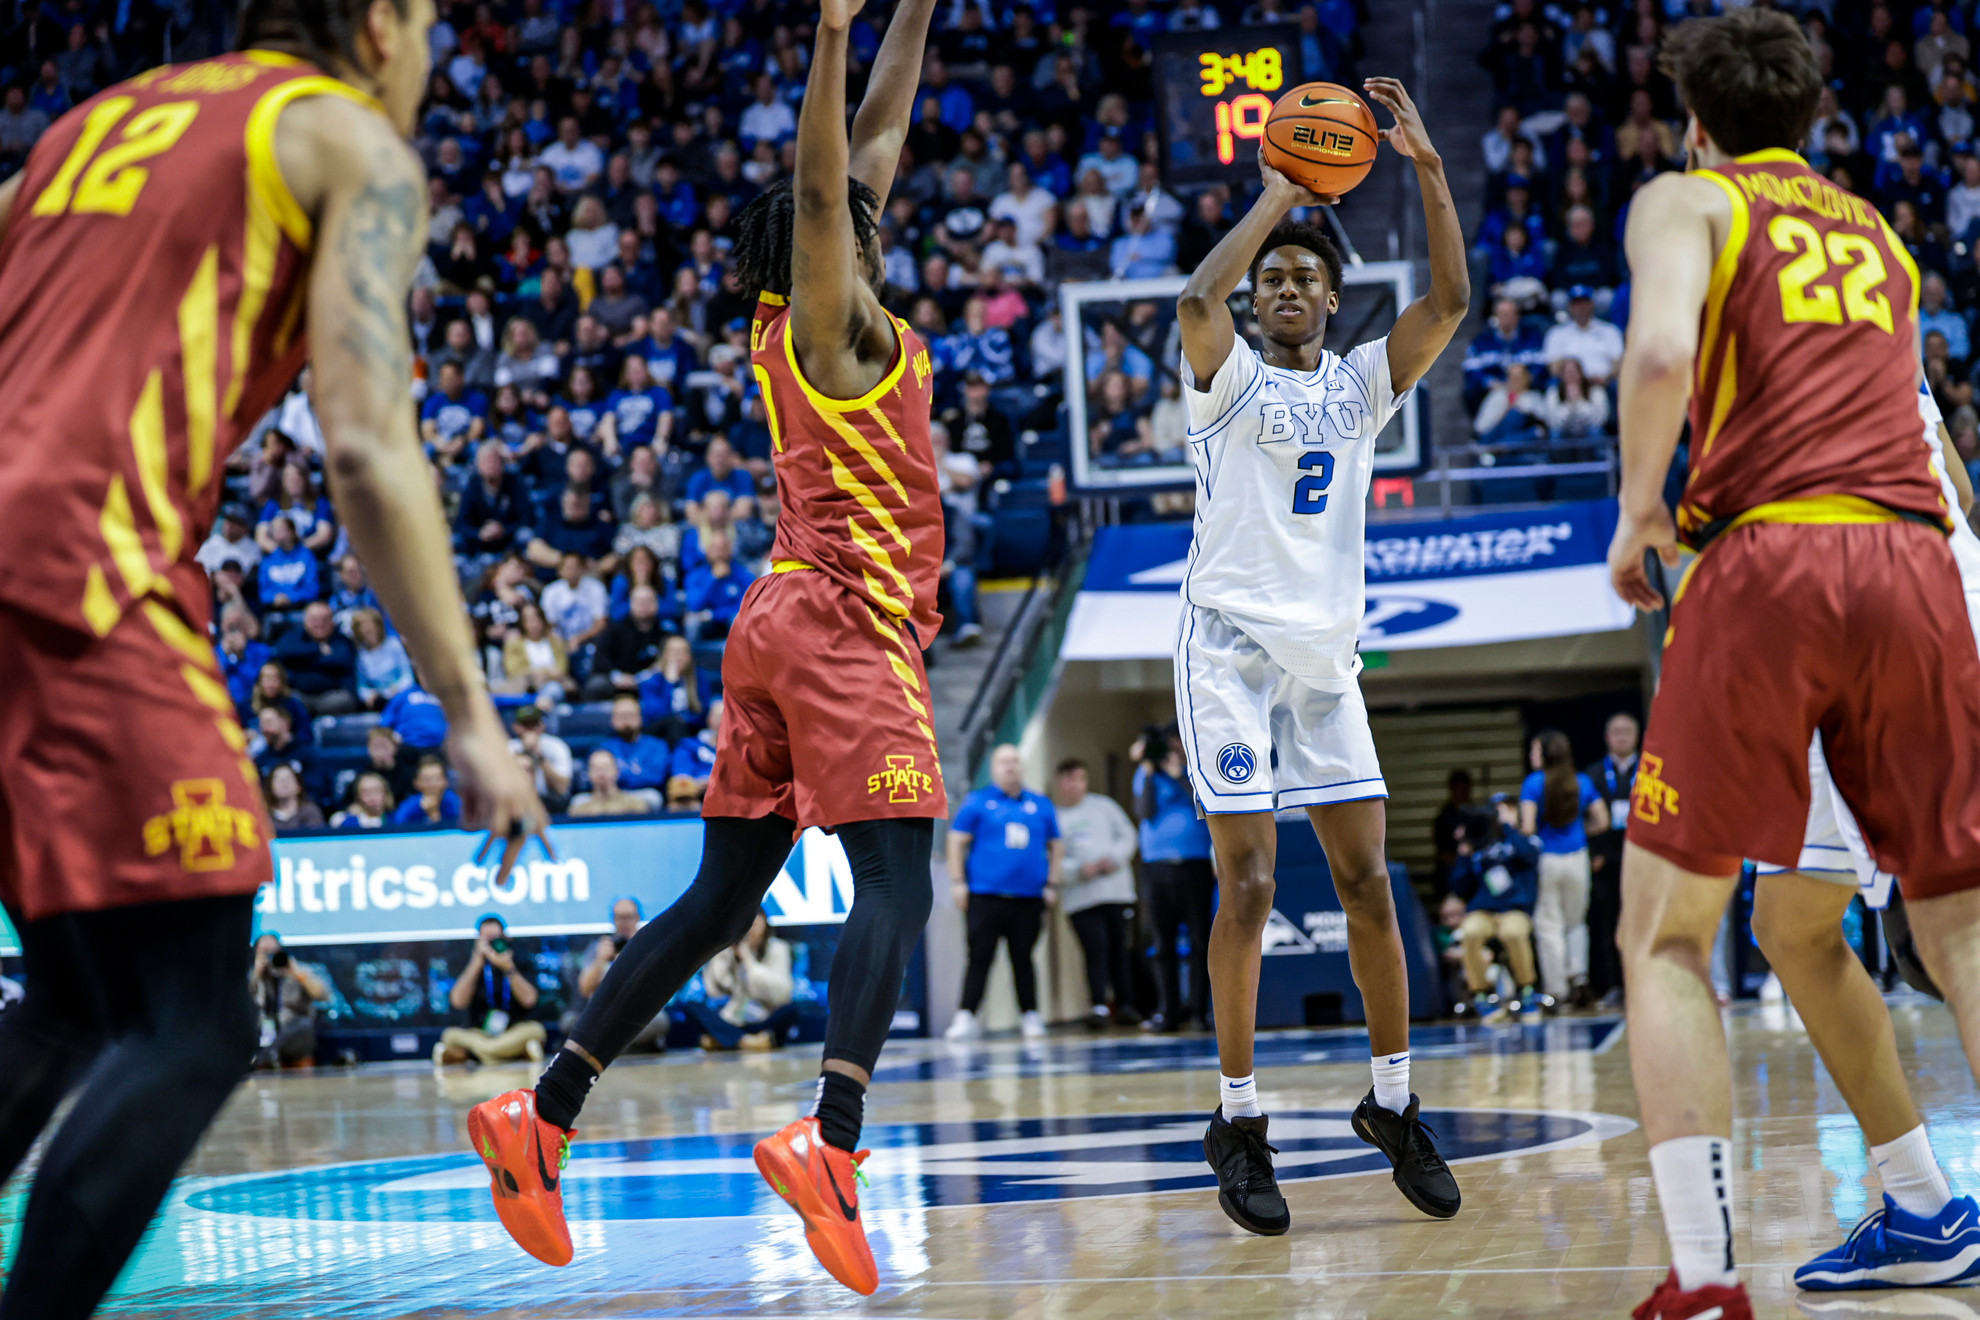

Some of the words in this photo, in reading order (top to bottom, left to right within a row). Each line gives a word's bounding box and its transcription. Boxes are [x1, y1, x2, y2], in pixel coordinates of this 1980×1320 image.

[1199, 47, 1283, 96] 3:48
[1215, 93, 1273, 165] 19
[1291, 142, 1352, 157] CHAMPIONSHIP
[1293, 125, 1354, 152] ELITE
[31, 95, 200, 217] 12
[1768, 214, 1894, 336] 22
[1257, 401, 1364, 444] BYU
[1292, 451, 1335, 515] 2
[867, 769, 933, 794] STATE
[1232, 767, 1244, 778] Y
